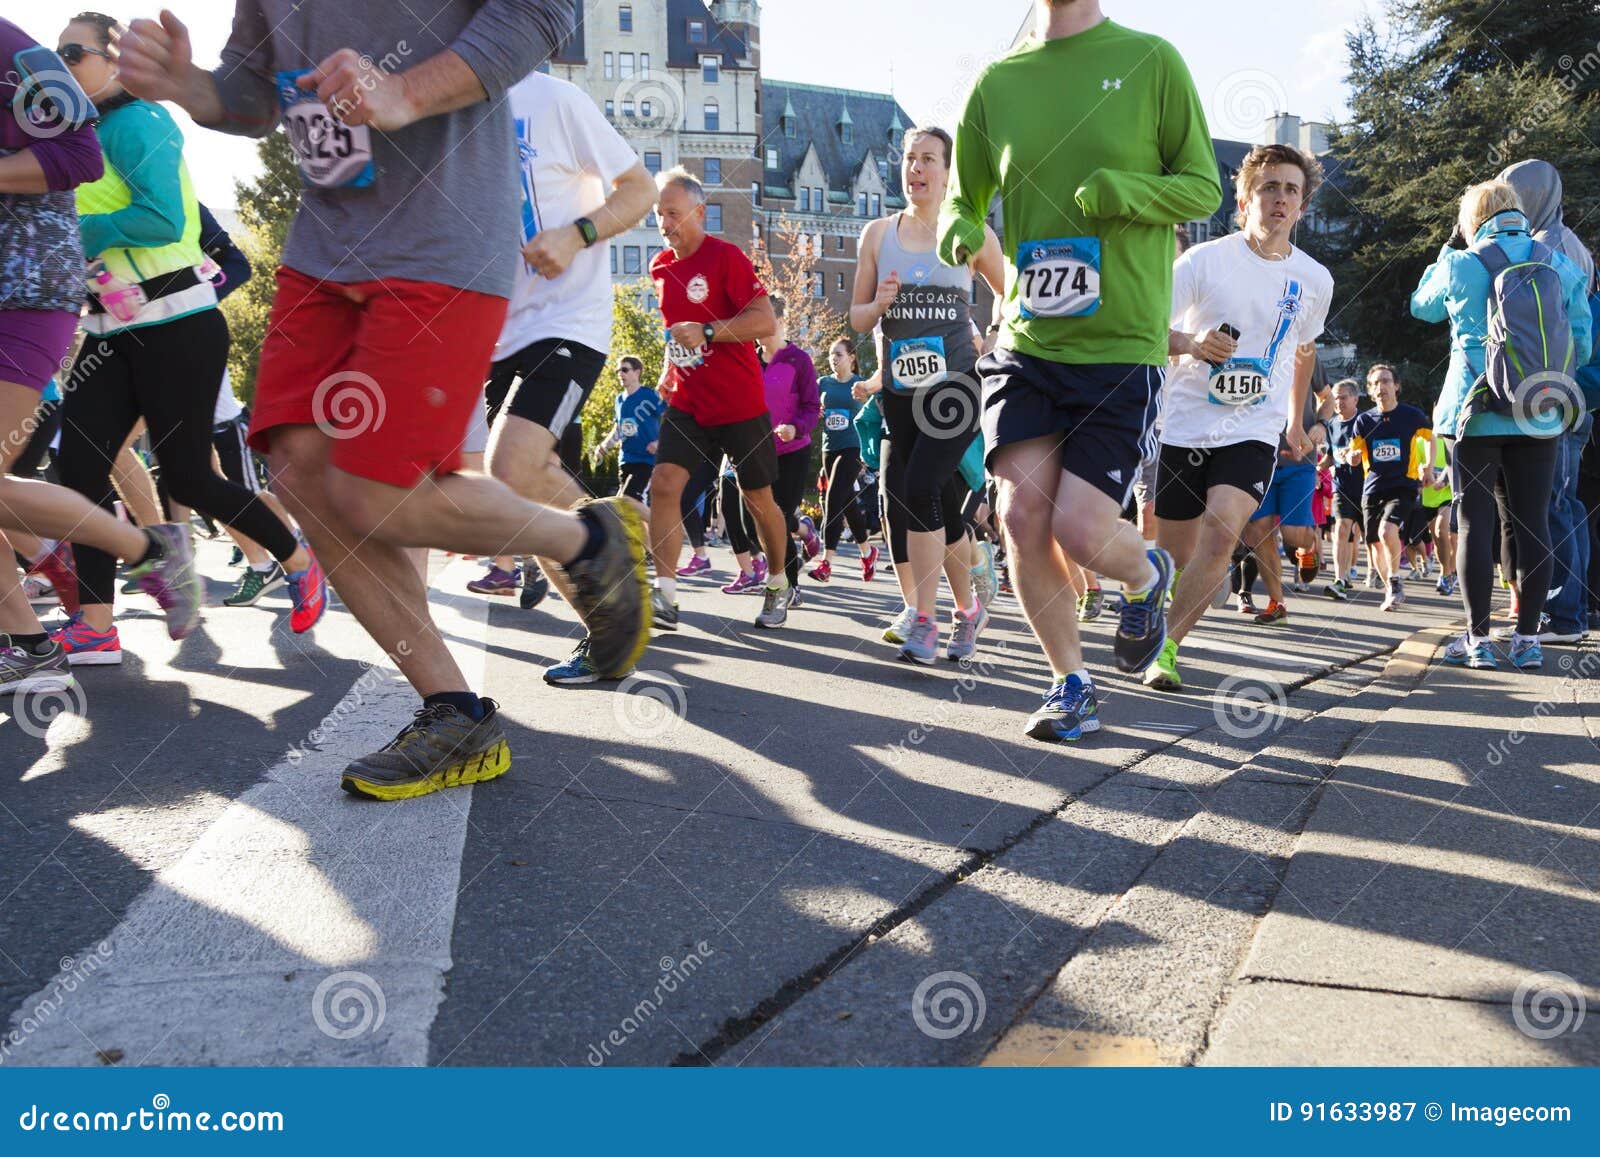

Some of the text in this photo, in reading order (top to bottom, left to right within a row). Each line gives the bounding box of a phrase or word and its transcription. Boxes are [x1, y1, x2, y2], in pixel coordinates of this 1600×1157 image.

[1024, 266, 1089, 298] 7274
[893, 292, 959, 305] ESTCOAST
[885, 307, 958, 320] RUNNING
[896, 354, 939, 377] 2056
[1215, 375, 1262, 394] 4150
[1375, 447, 1396, 457] 2521
